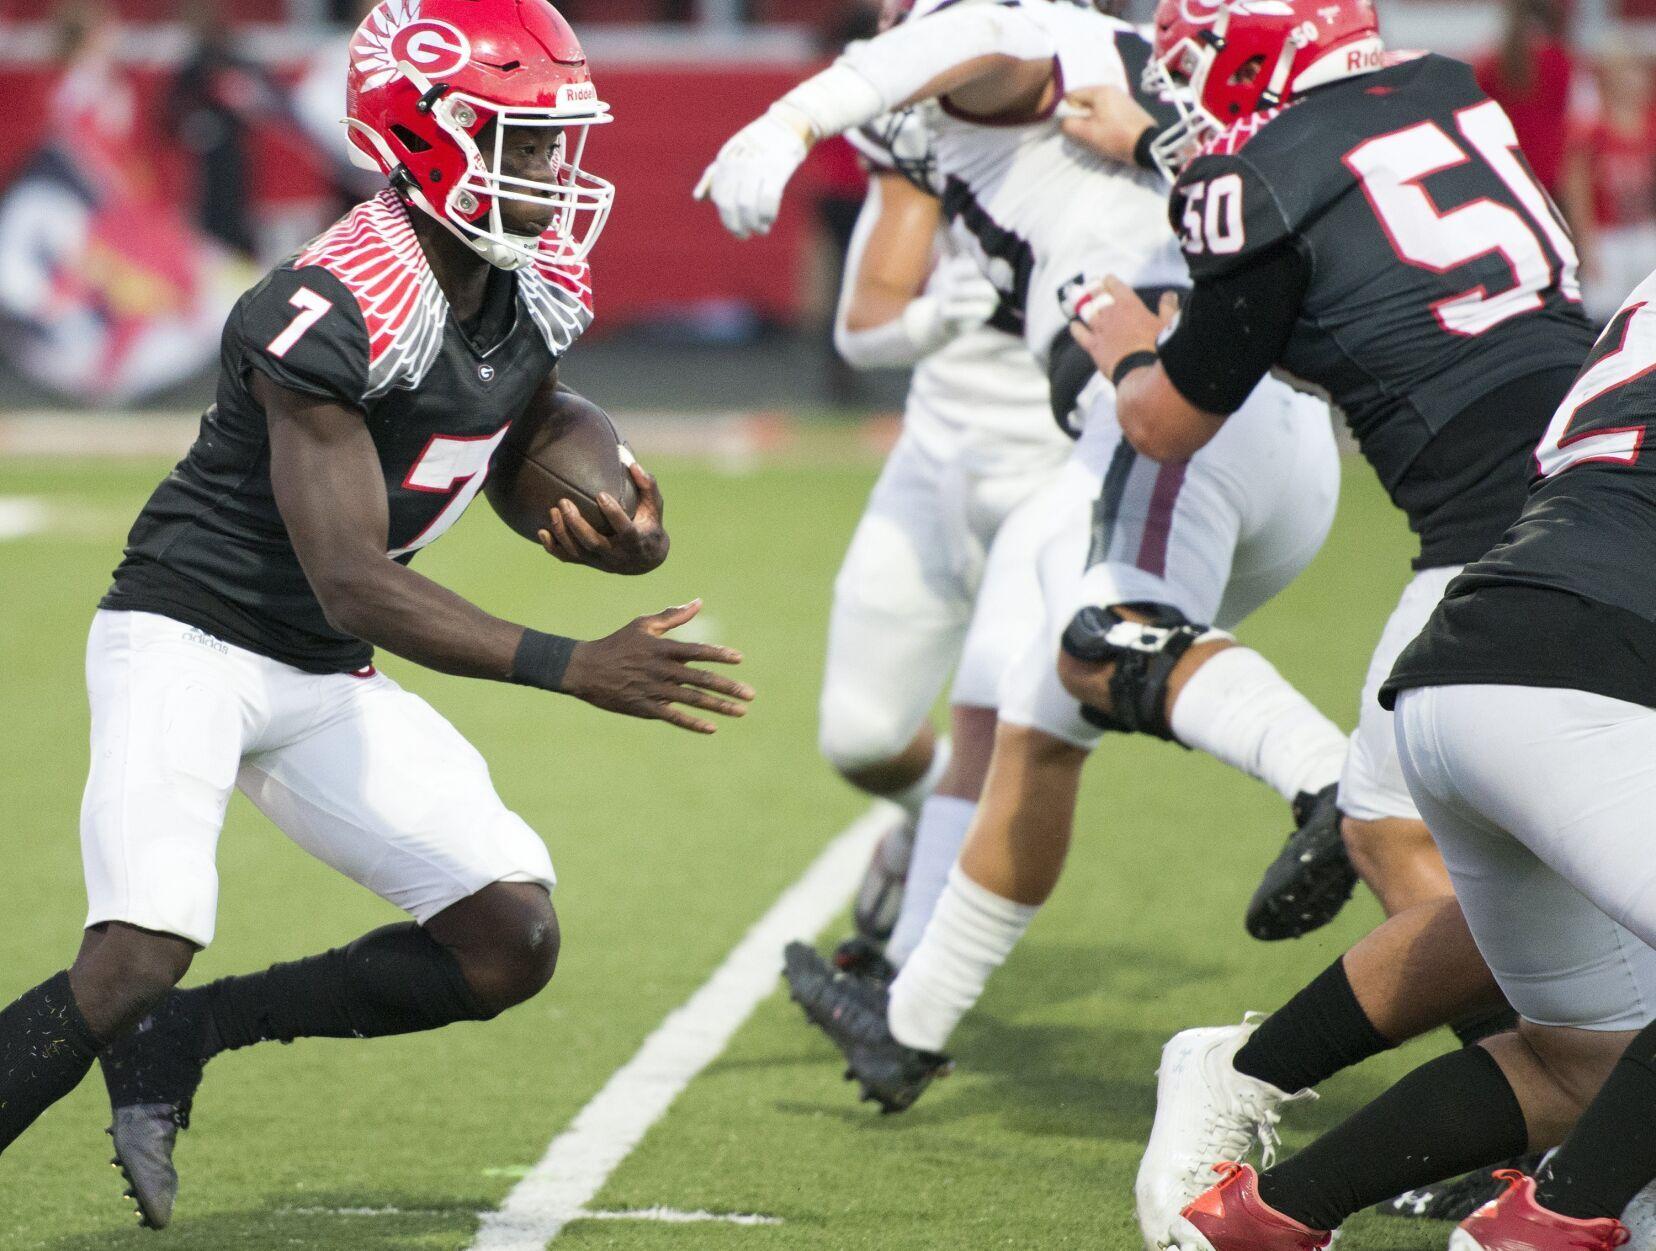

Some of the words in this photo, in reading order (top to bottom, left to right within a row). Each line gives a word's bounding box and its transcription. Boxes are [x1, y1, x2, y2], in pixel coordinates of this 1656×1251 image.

[1290, 20, 1319, 49] 50
[1180, 173, 1246, 255] 50
[266, 286, 333, 359] 7
[387, 419, 513, 560] 7
[182, 632, 228, 654] adidas
